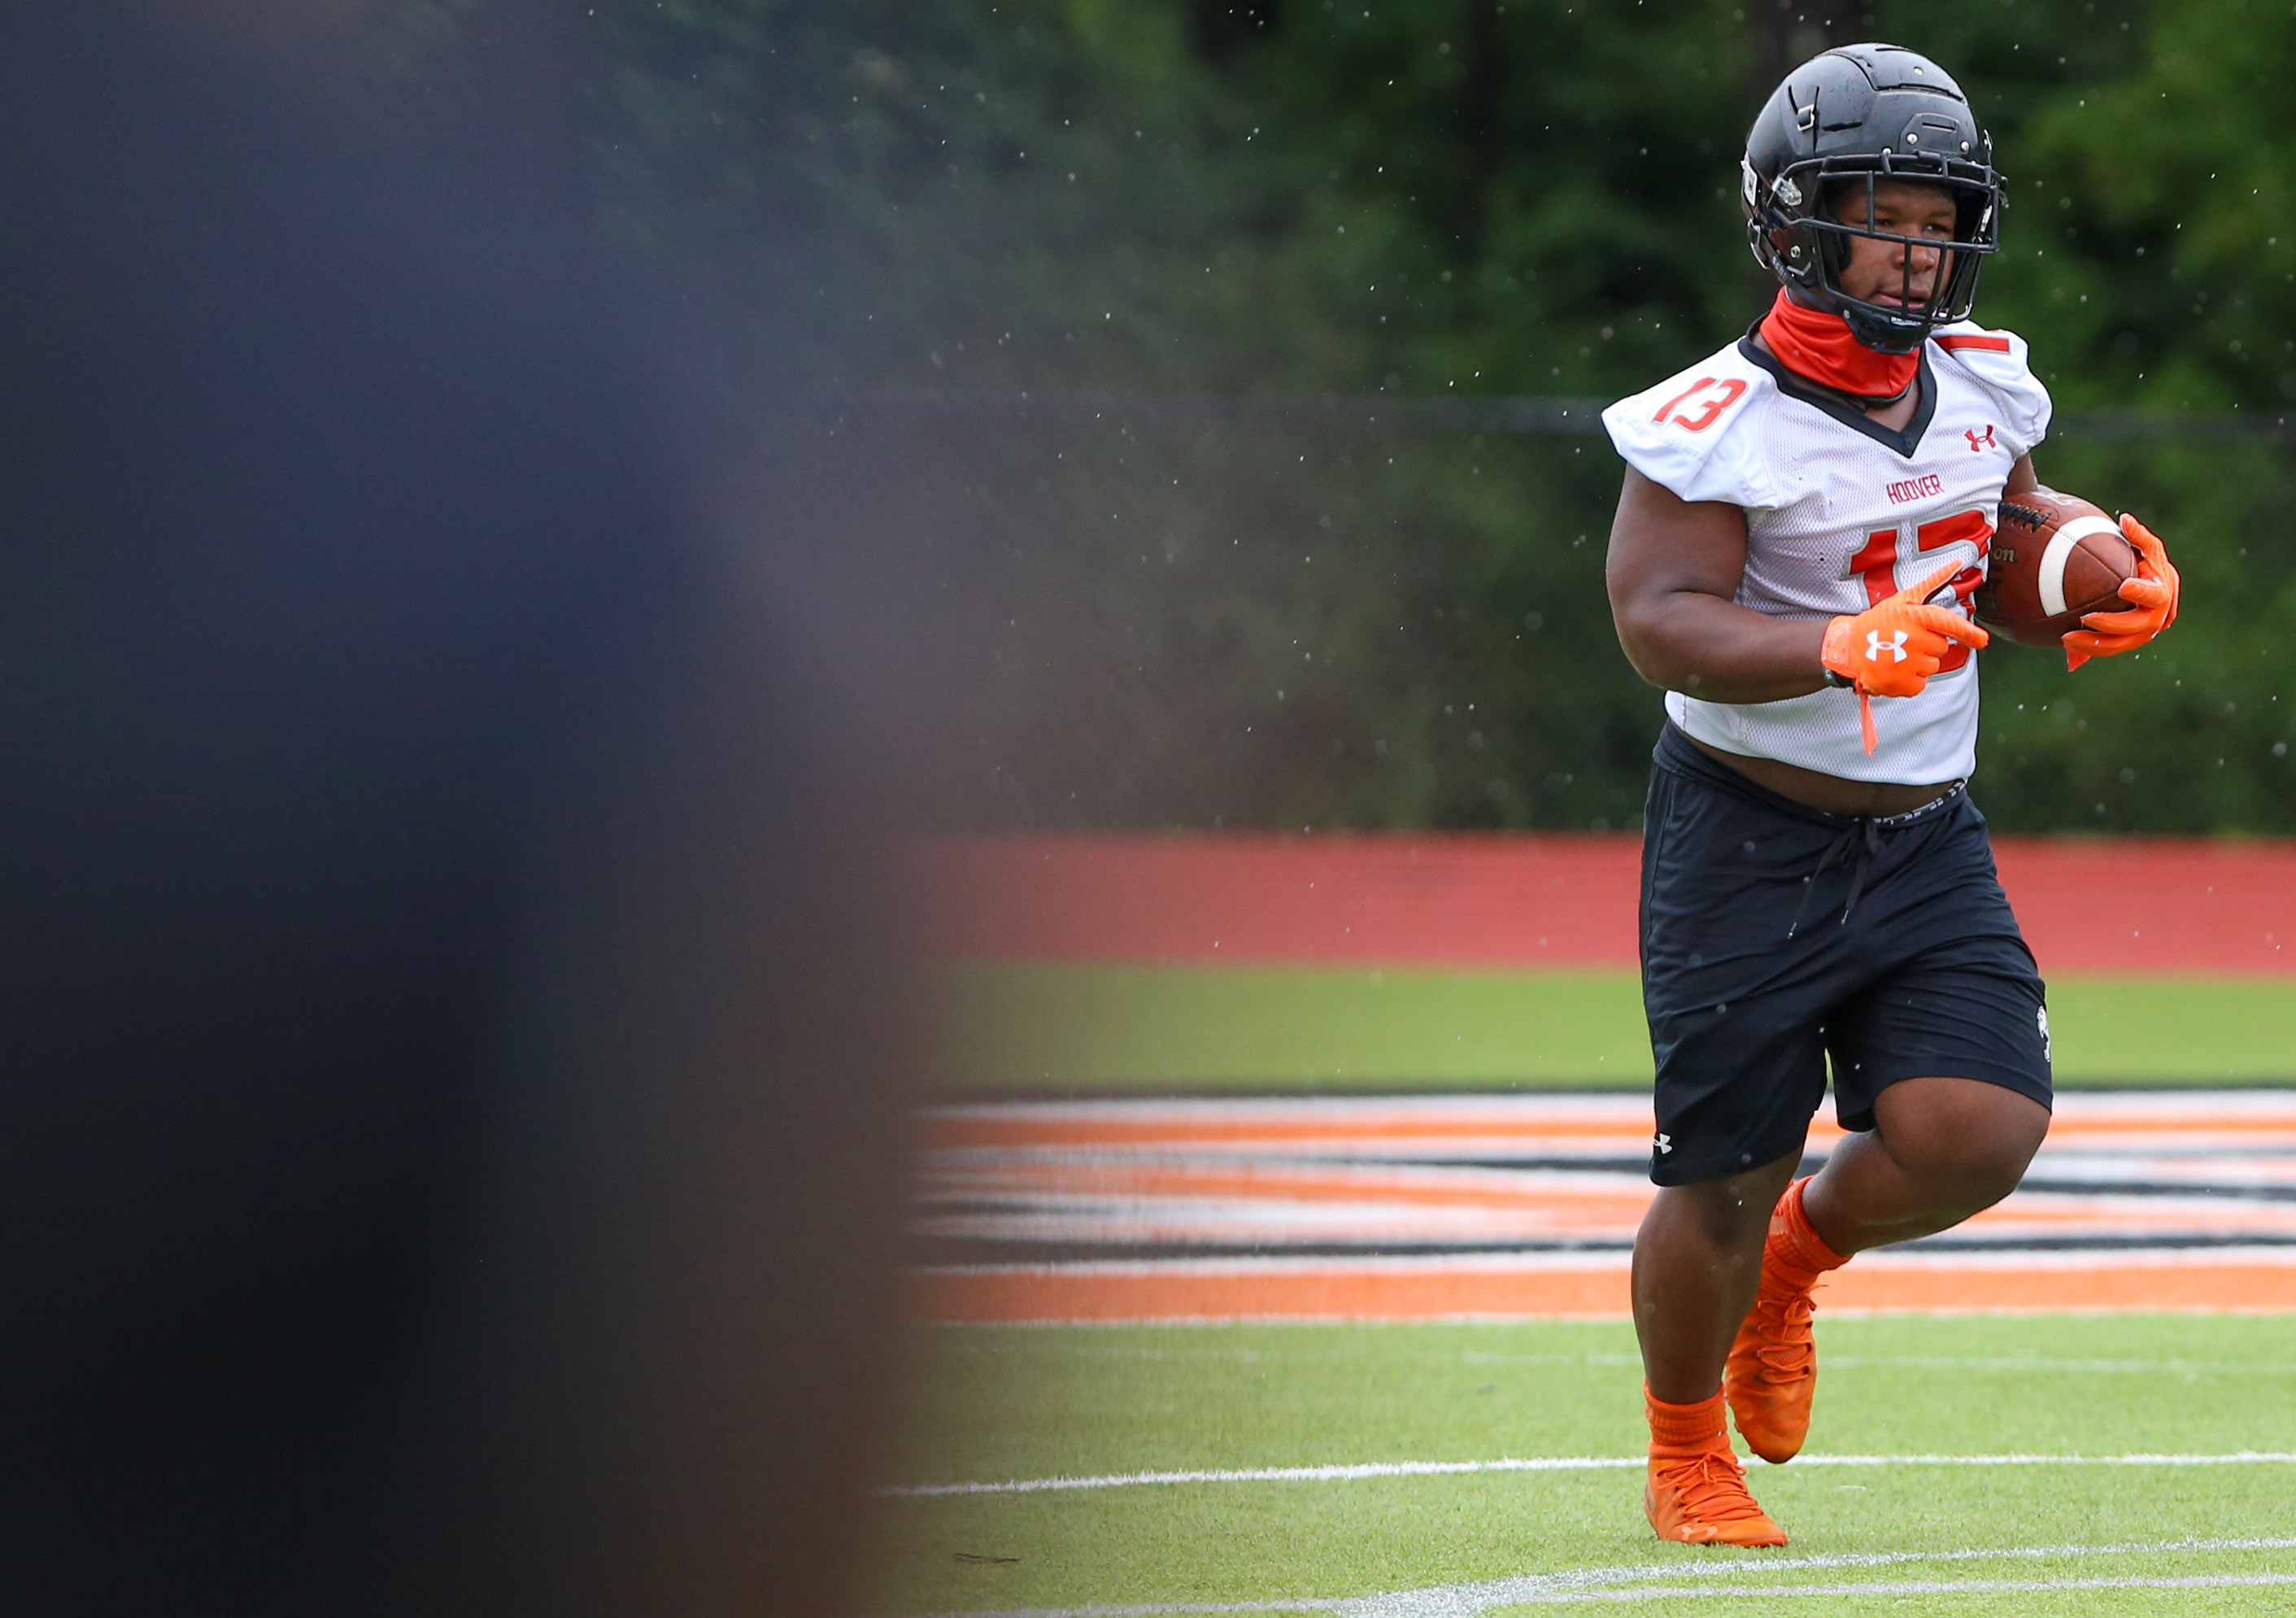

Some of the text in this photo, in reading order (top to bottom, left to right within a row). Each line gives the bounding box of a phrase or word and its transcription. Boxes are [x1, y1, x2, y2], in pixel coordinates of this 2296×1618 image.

[1653, 377, 1748, 432] 13
[1887, 474, 1944, 504] HOOVER
[1990, 546, 2015, 562] on
